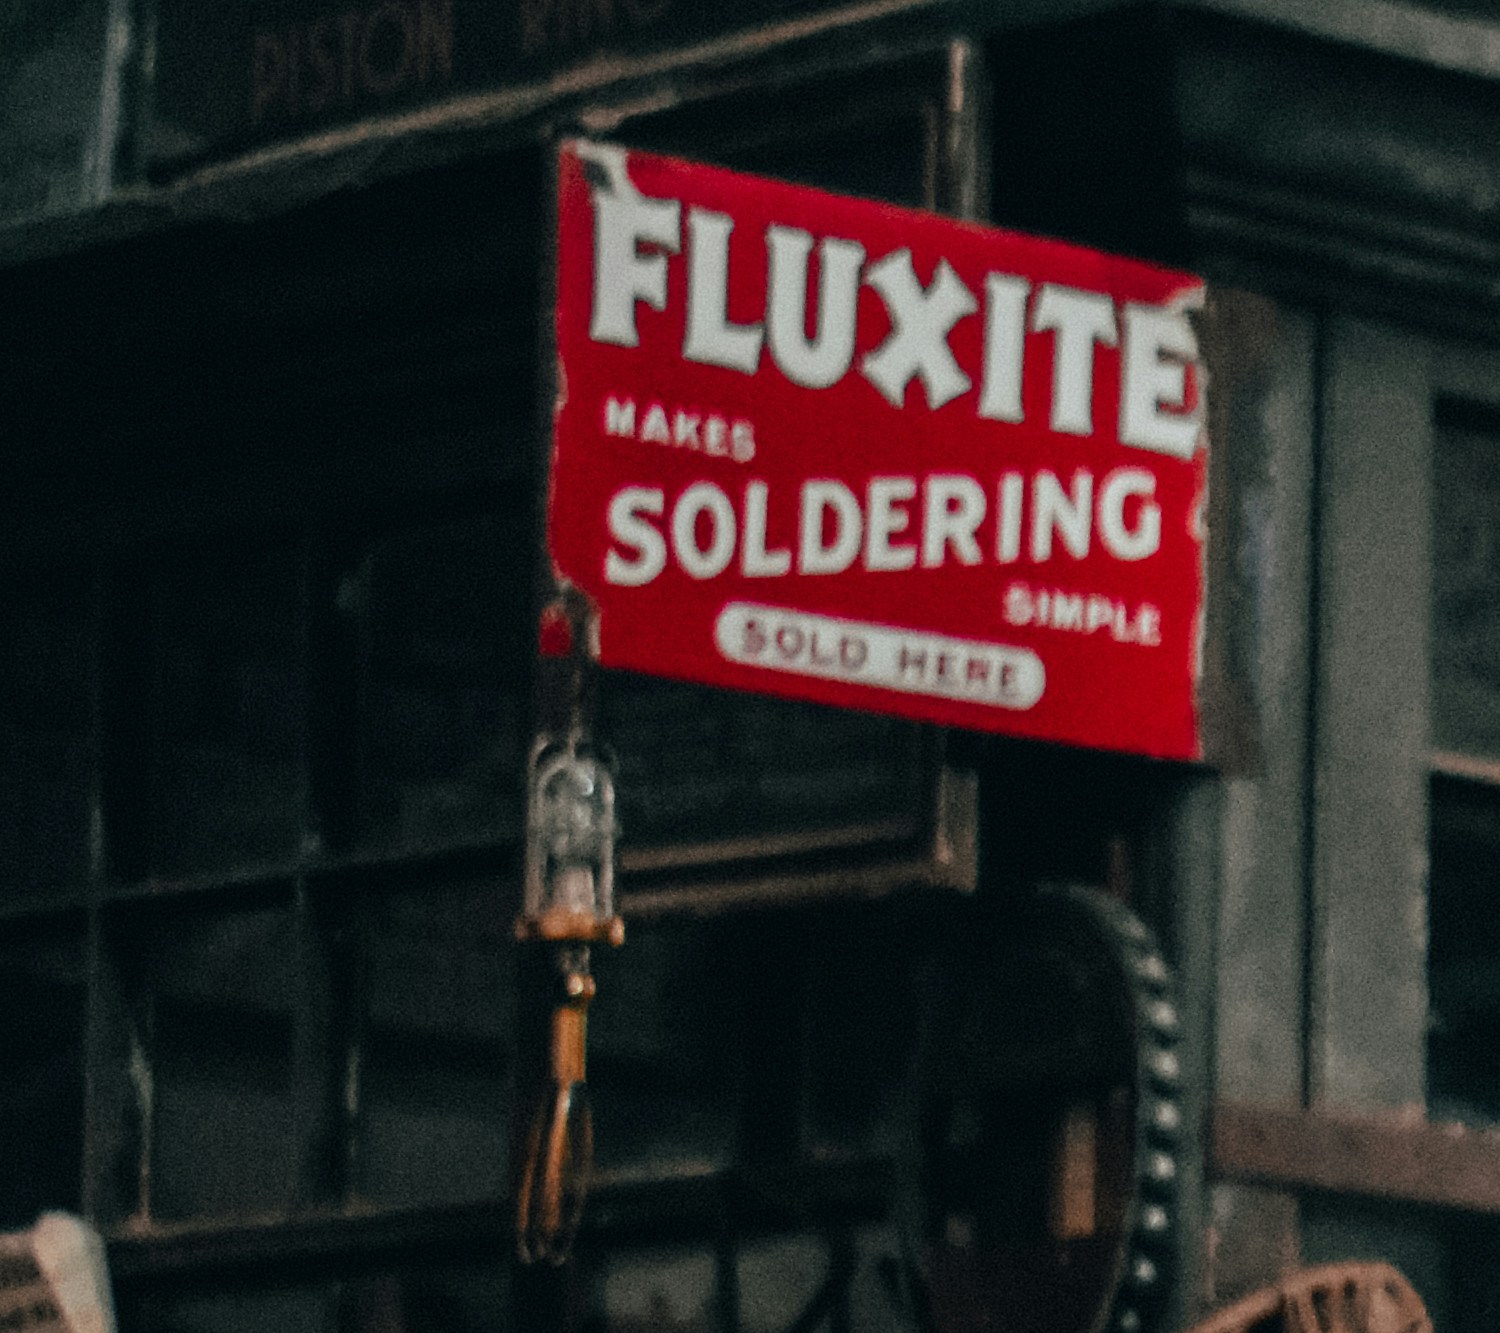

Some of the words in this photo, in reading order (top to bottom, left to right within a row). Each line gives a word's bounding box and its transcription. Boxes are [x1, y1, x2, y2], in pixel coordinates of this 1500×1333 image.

[250, 0, 456, 124] PISTON
[588, 185, 1206, 462] FLUXITE
[604, 397, 757, 463] MAKES
[603, 466, 1162, 588] SOLDERING
[738, 618, 868, 672] SOLD
[898, 645, 1022, 697] HERE
[1002, 580, 1162, 646] SIMPLE
